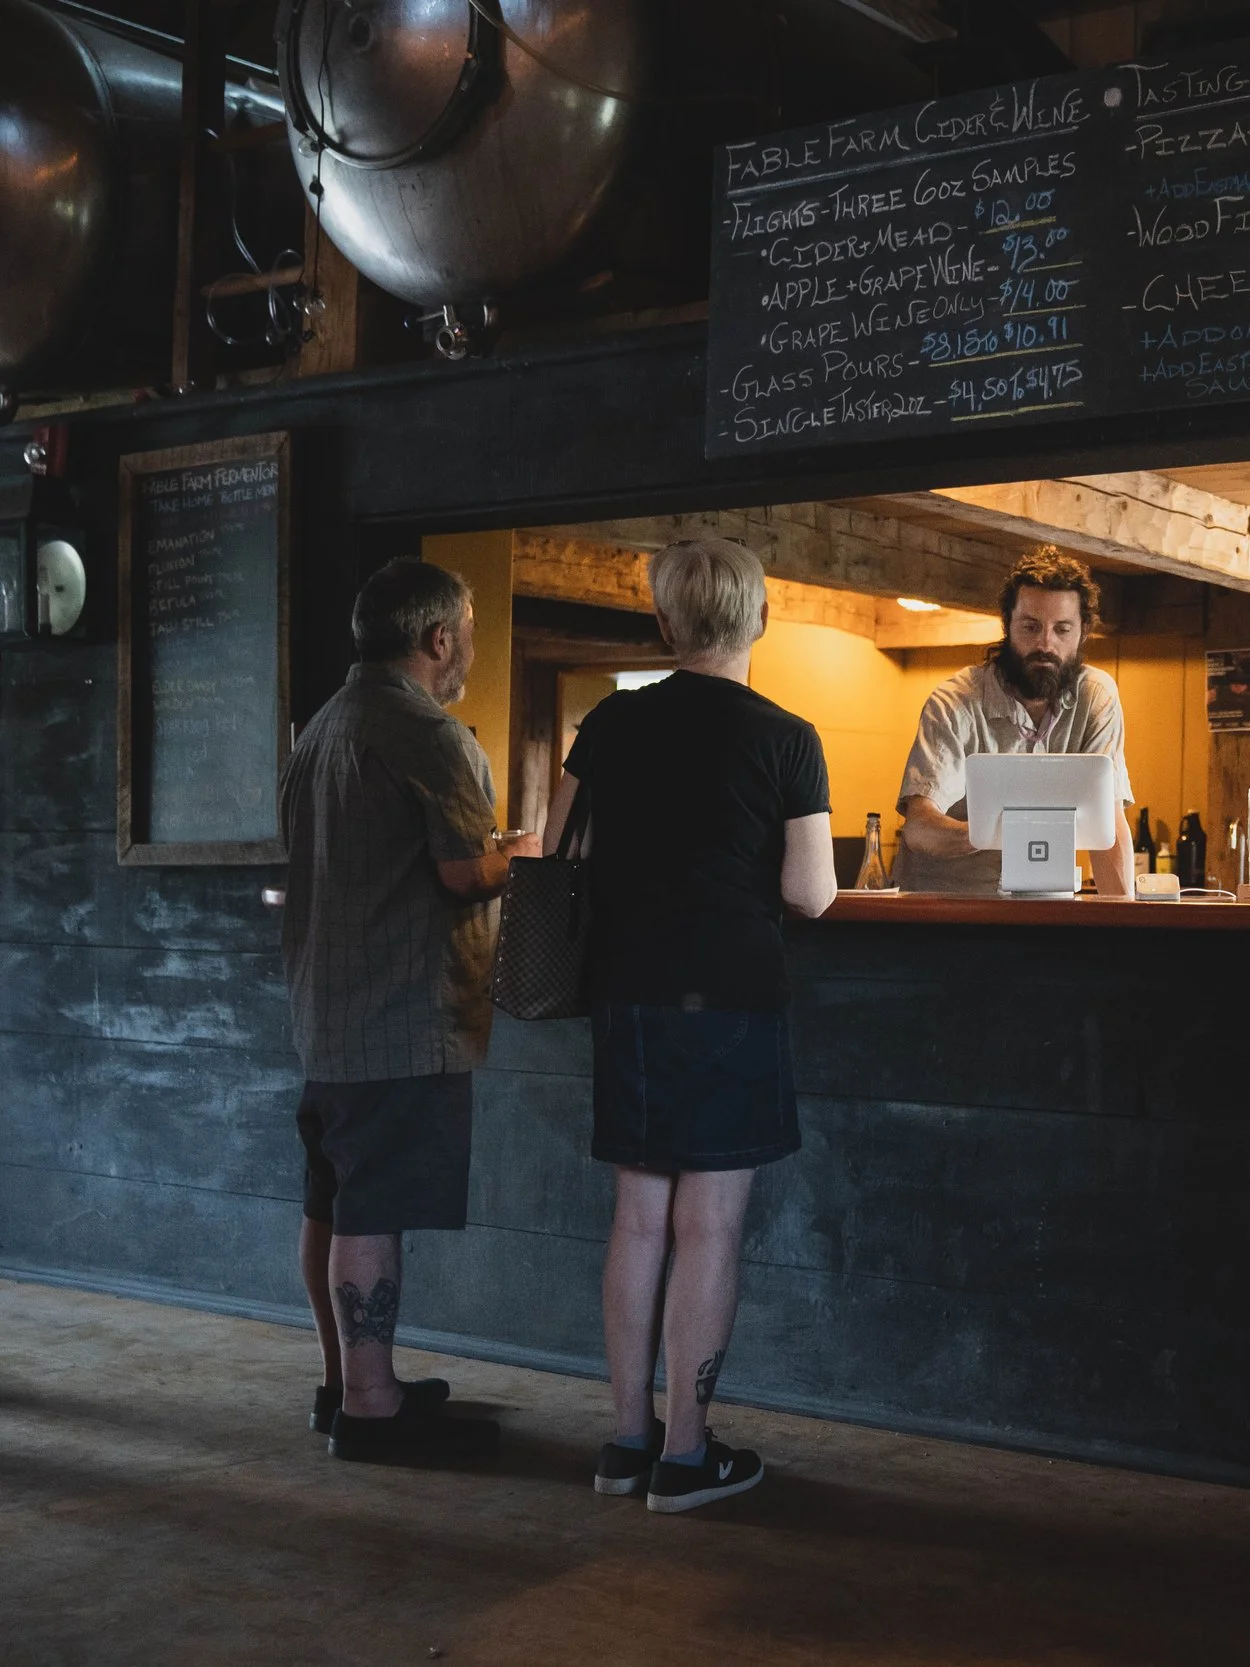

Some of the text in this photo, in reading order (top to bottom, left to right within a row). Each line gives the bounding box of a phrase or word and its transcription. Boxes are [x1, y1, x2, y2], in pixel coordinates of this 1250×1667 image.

[1119, 63, 1249, 108] TASTING
[726, 78, 1091, 187] FABLE FARM CIDER & WINE
[972, 151, 1077, 192] SAMPLES
[852, 303, 930, 336] WINE
[828, 386, 891, 422] TASTER
[182, 472, 212, 491] FARM
[256, 483, 278, 497] MEN
